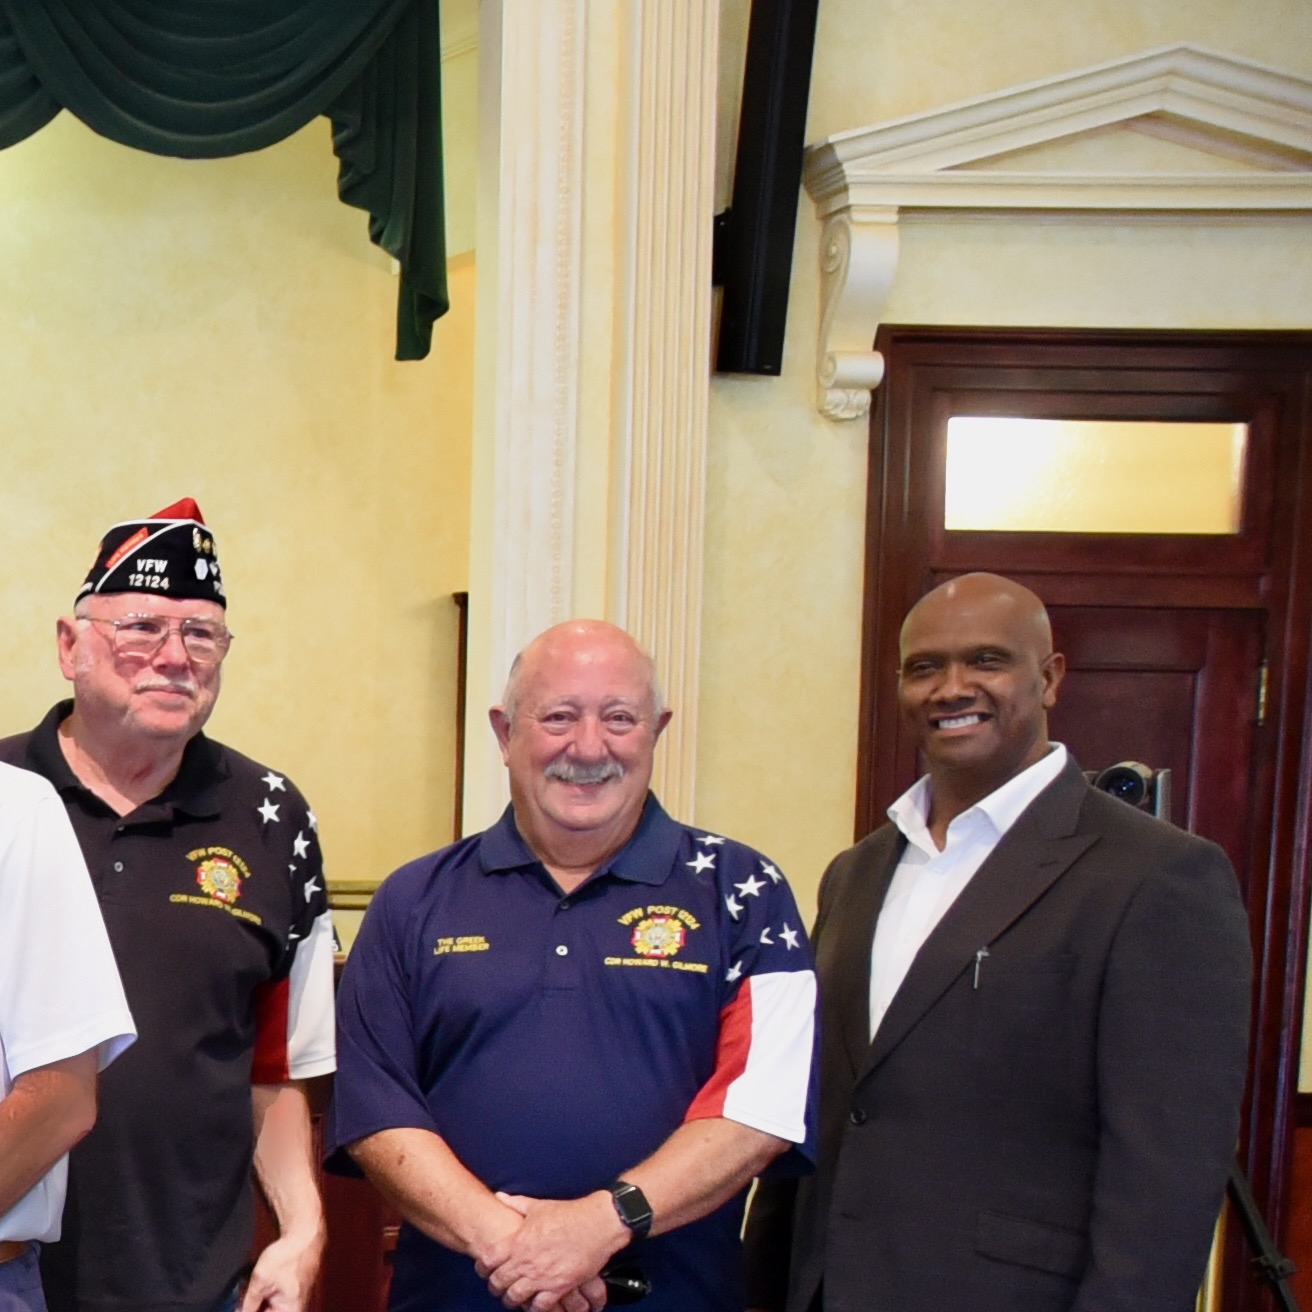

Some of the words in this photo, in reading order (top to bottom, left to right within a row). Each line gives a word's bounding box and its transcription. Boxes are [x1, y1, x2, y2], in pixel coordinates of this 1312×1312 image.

[136, 558, 169, 574] VFW
[128, 573, 170, 591] 12124
[207, 846, 234, 859] POST
[617, 907, 644, 926] VFW
[647, 905, 679, 916] POST
[436, 937, 454, 947] THE
[433, 945, 452, 956] LIFE
[451, 943, 490, 953] MEMBER
[622, 958, 659, 967] HOWARD
